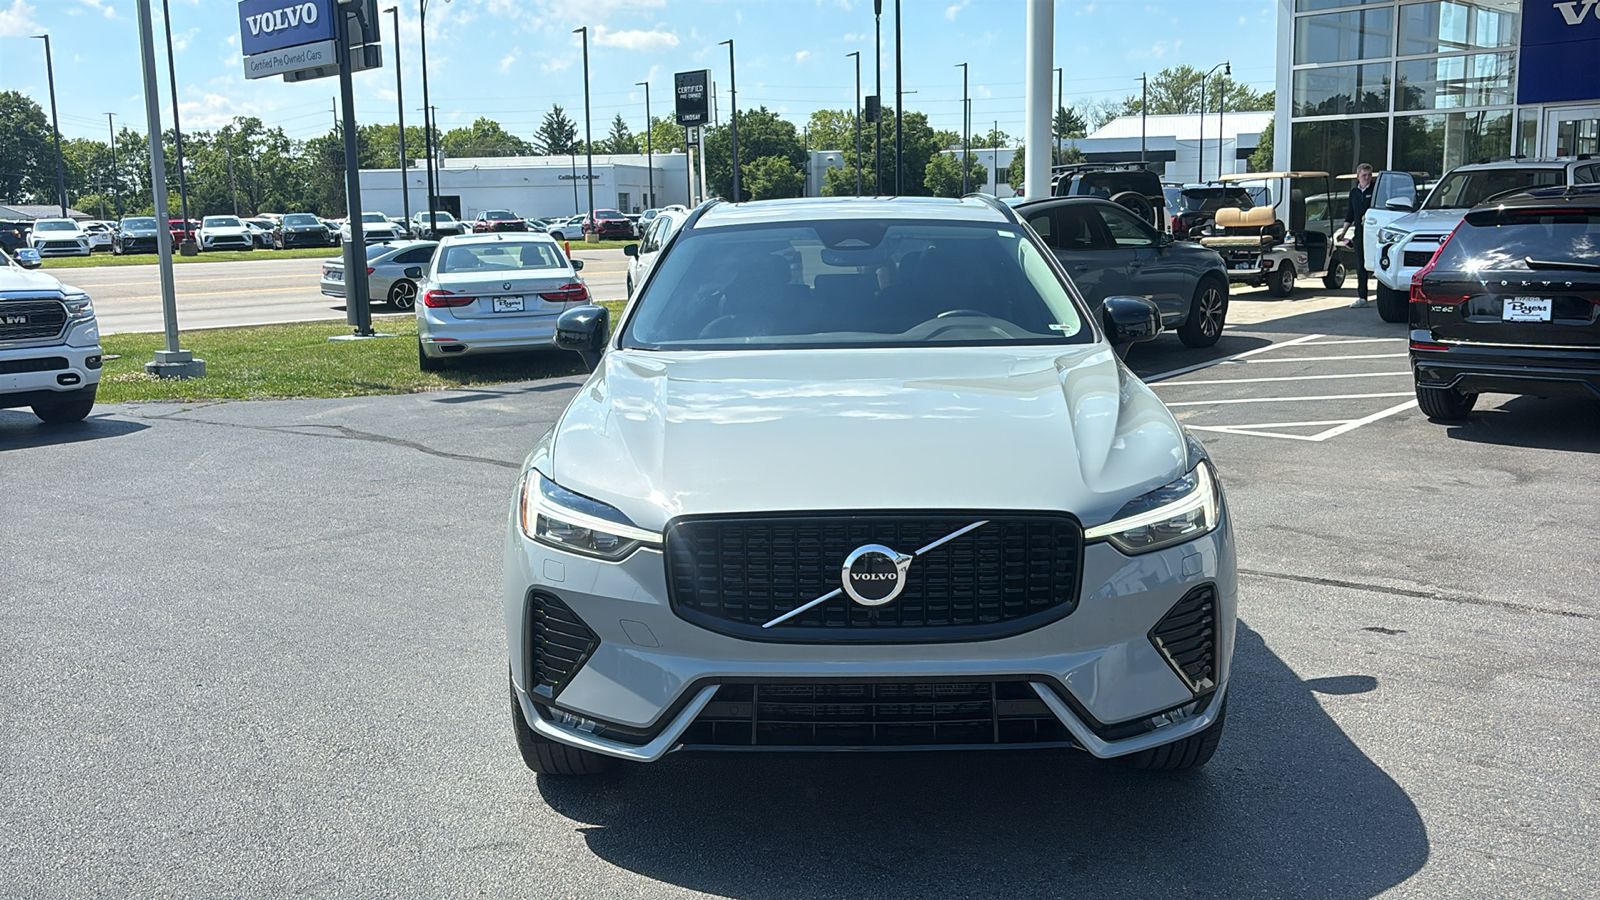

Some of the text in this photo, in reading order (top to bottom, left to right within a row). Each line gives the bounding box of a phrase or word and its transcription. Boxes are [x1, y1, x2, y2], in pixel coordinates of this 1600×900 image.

[246, 2, 318, 35] VOLVO
[1553, 0, 1600, 25] V
[250, 50, 322, 71] Certified Pre Owned Cars
[677, 85, 704, 94] CERTIFIED
[496, 300, 521, 308] Byers
[1508, 302, 1548, 314] Byers
